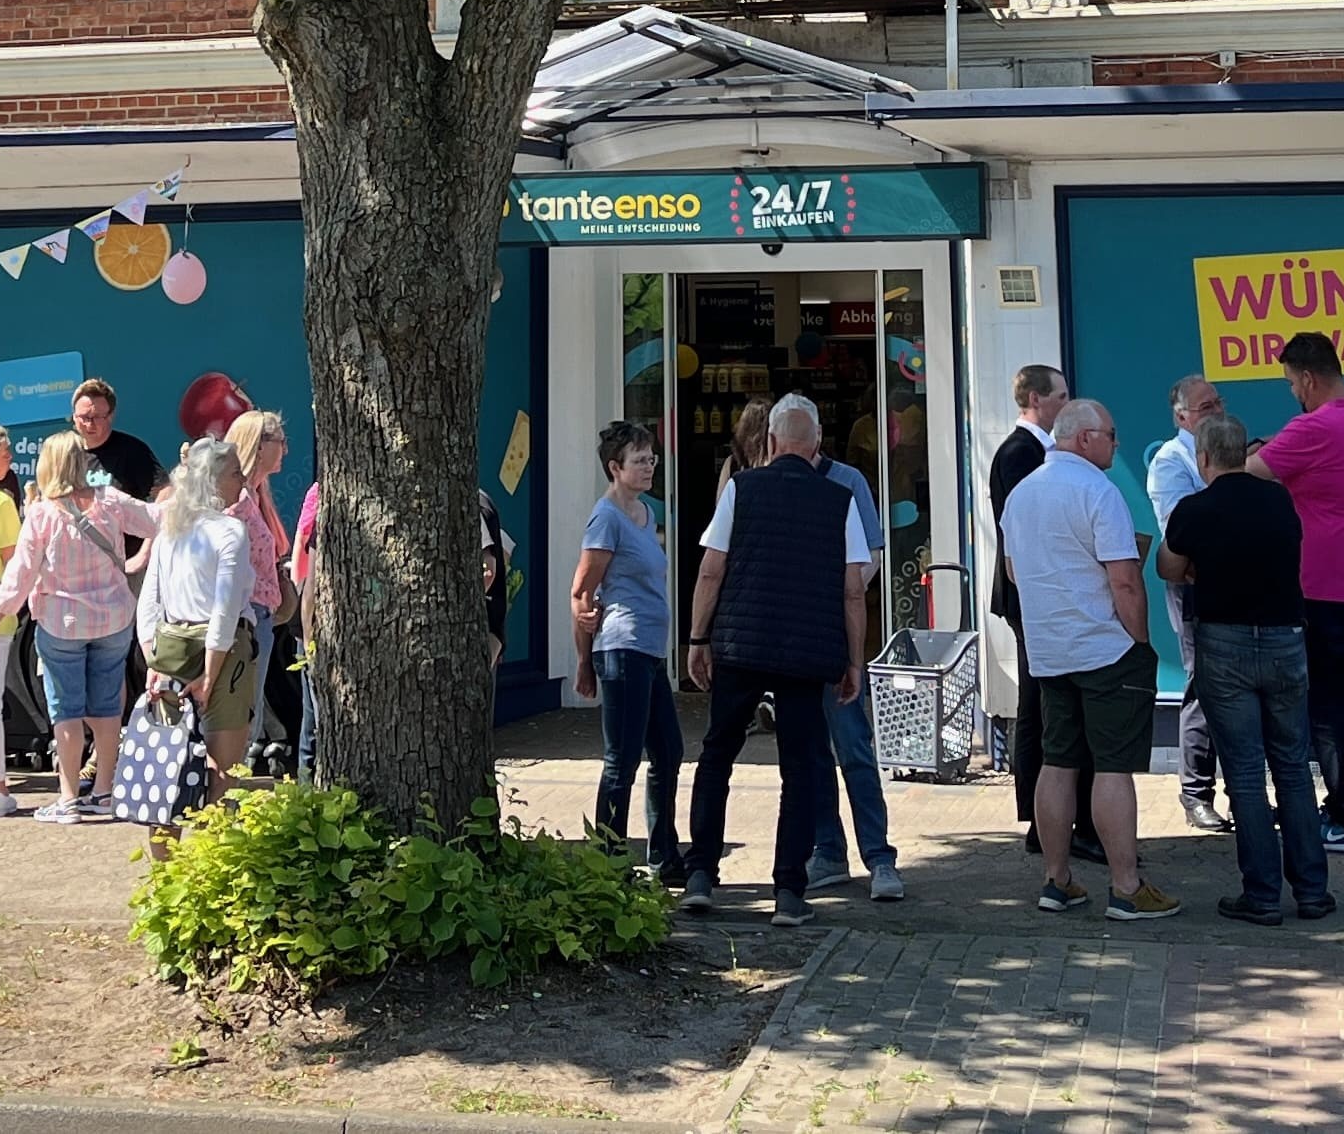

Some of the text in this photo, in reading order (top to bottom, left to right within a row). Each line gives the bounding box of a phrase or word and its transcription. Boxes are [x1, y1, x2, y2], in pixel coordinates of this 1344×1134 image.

[518, 190, 700, 221] tanteenso
[750, 180, 832, 215] 24/7
[580, 222, 701, 235] MEINE ENTSCHEIDUNG
[753, 210, 834, 229] EINKAUFEN
